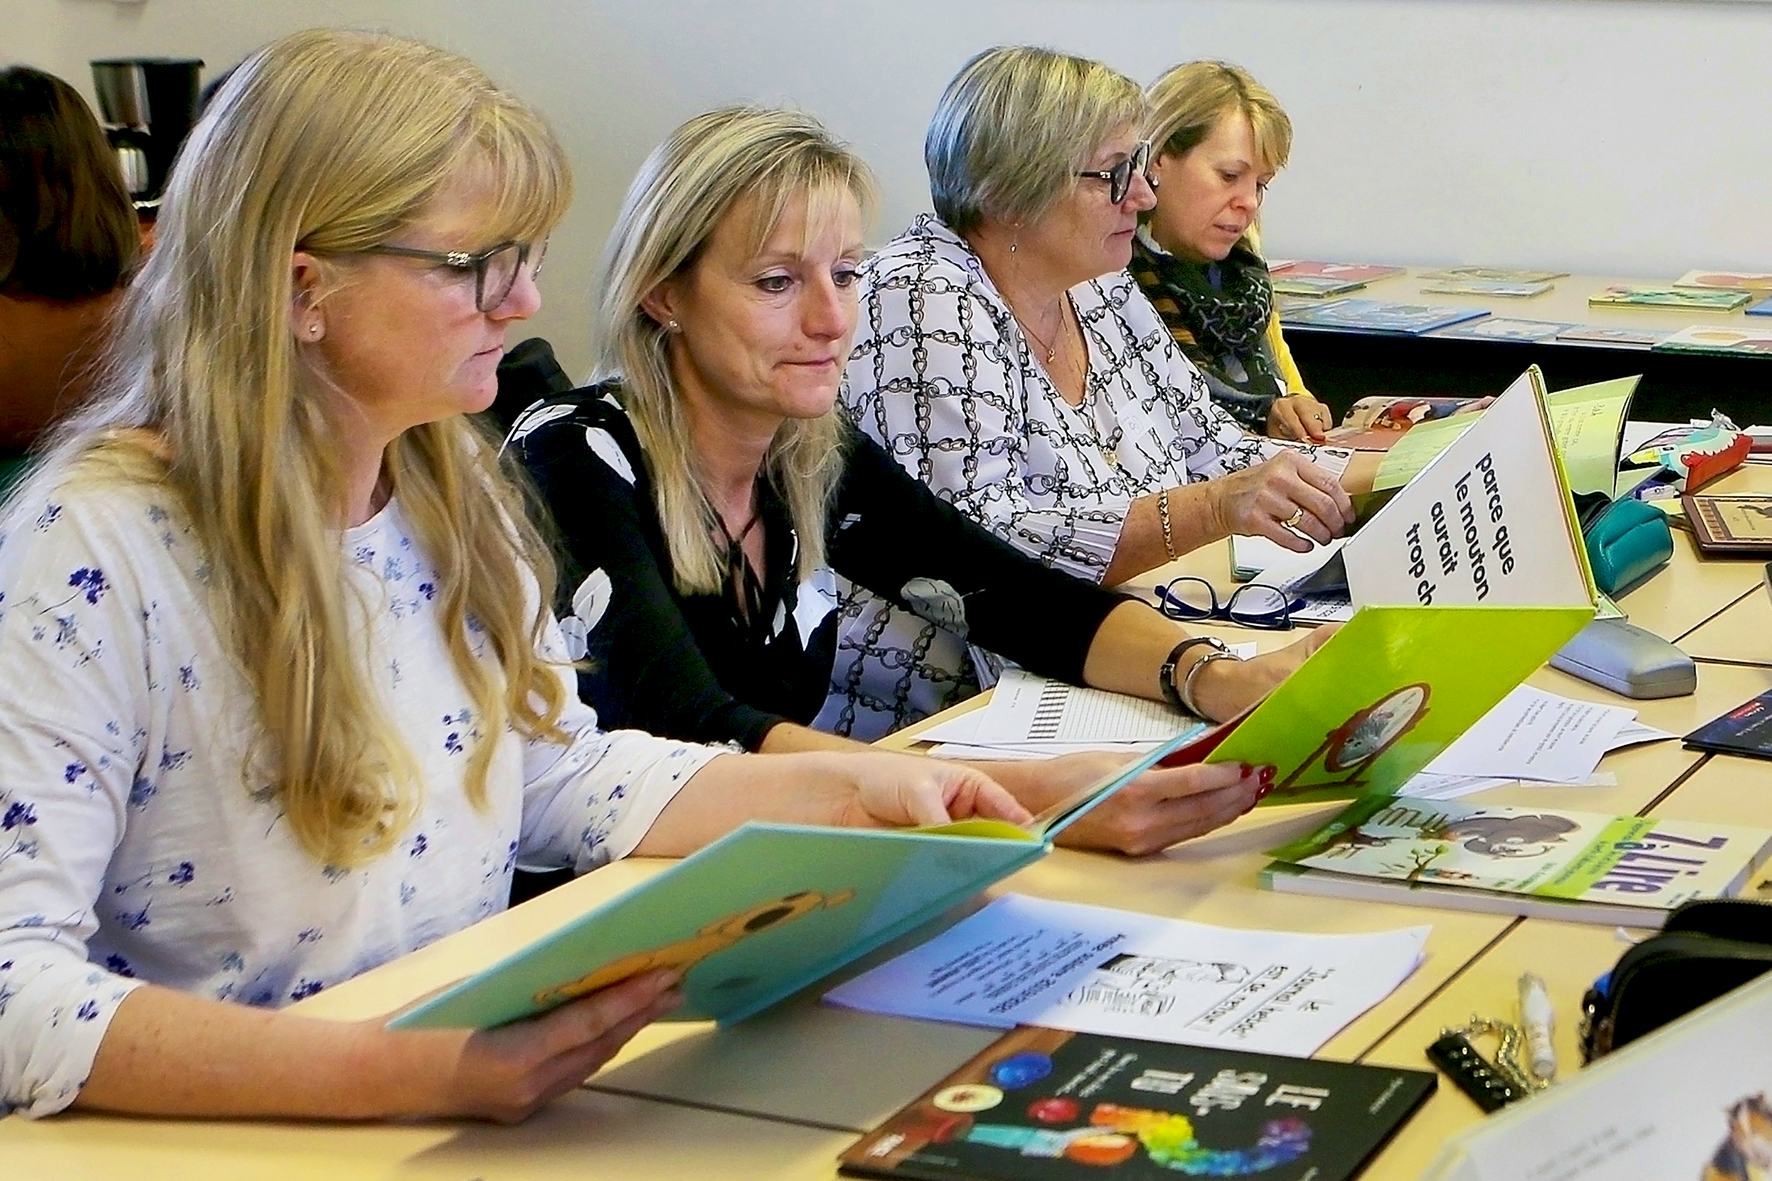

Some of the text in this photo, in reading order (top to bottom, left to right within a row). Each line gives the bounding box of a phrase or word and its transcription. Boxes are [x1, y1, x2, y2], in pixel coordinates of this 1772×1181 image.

[1430, 501, 1459, 576] aurait
[1454, 470, 1490, 601] le mouton
[1475, 452, 1515, 576] parce que
[1405, 522, 1428, 580] trop
[1590, 852, 1708, 893] Lire
[1265, 1083, 1330, 1111] LE
